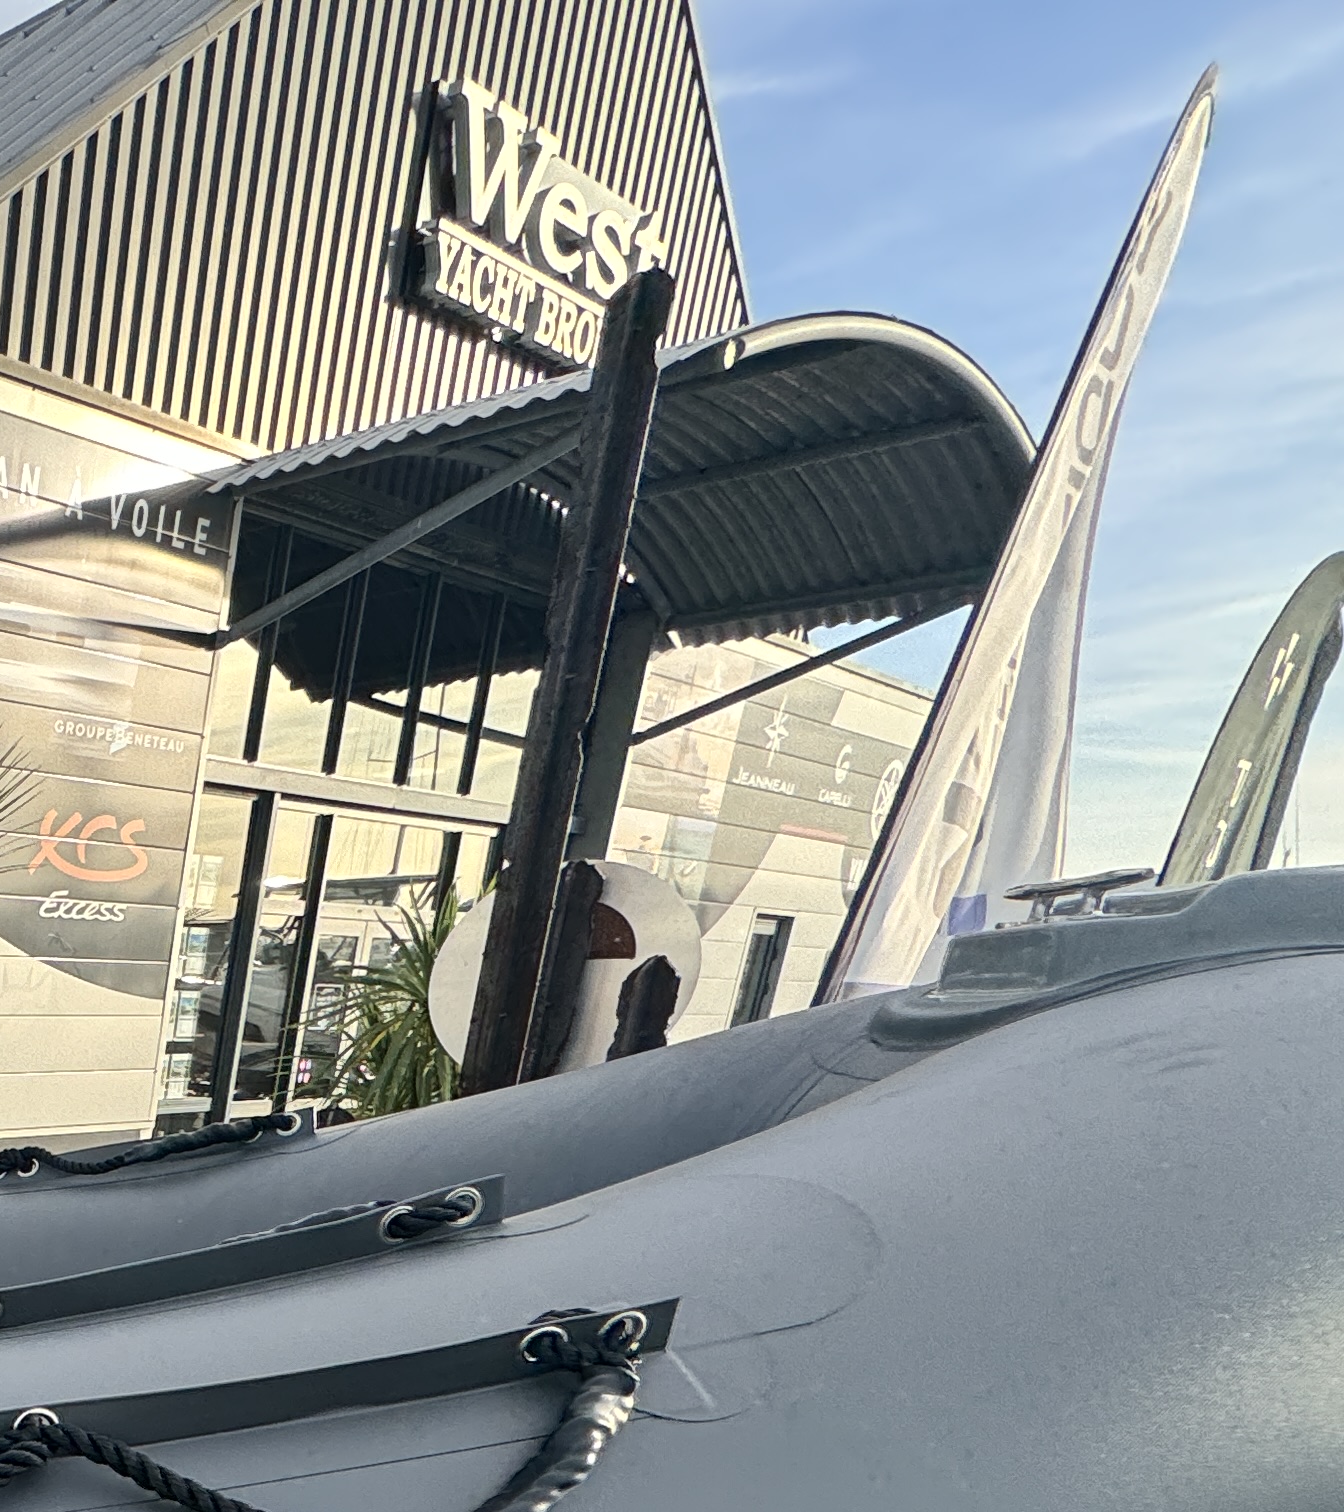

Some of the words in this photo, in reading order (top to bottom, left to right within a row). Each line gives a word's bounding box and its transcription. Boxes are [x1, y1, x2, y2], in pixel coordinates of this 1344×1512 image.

[434, 228, 537, 335] YACHT
[533, 288, 603, 369] BRO
[108, 493, 211, 556] VOILE
[53, 719, 113, 742] GROUPE
[731, 766, 796, 796] JEANNEAU
[38, 890, 126, 922] Excess
